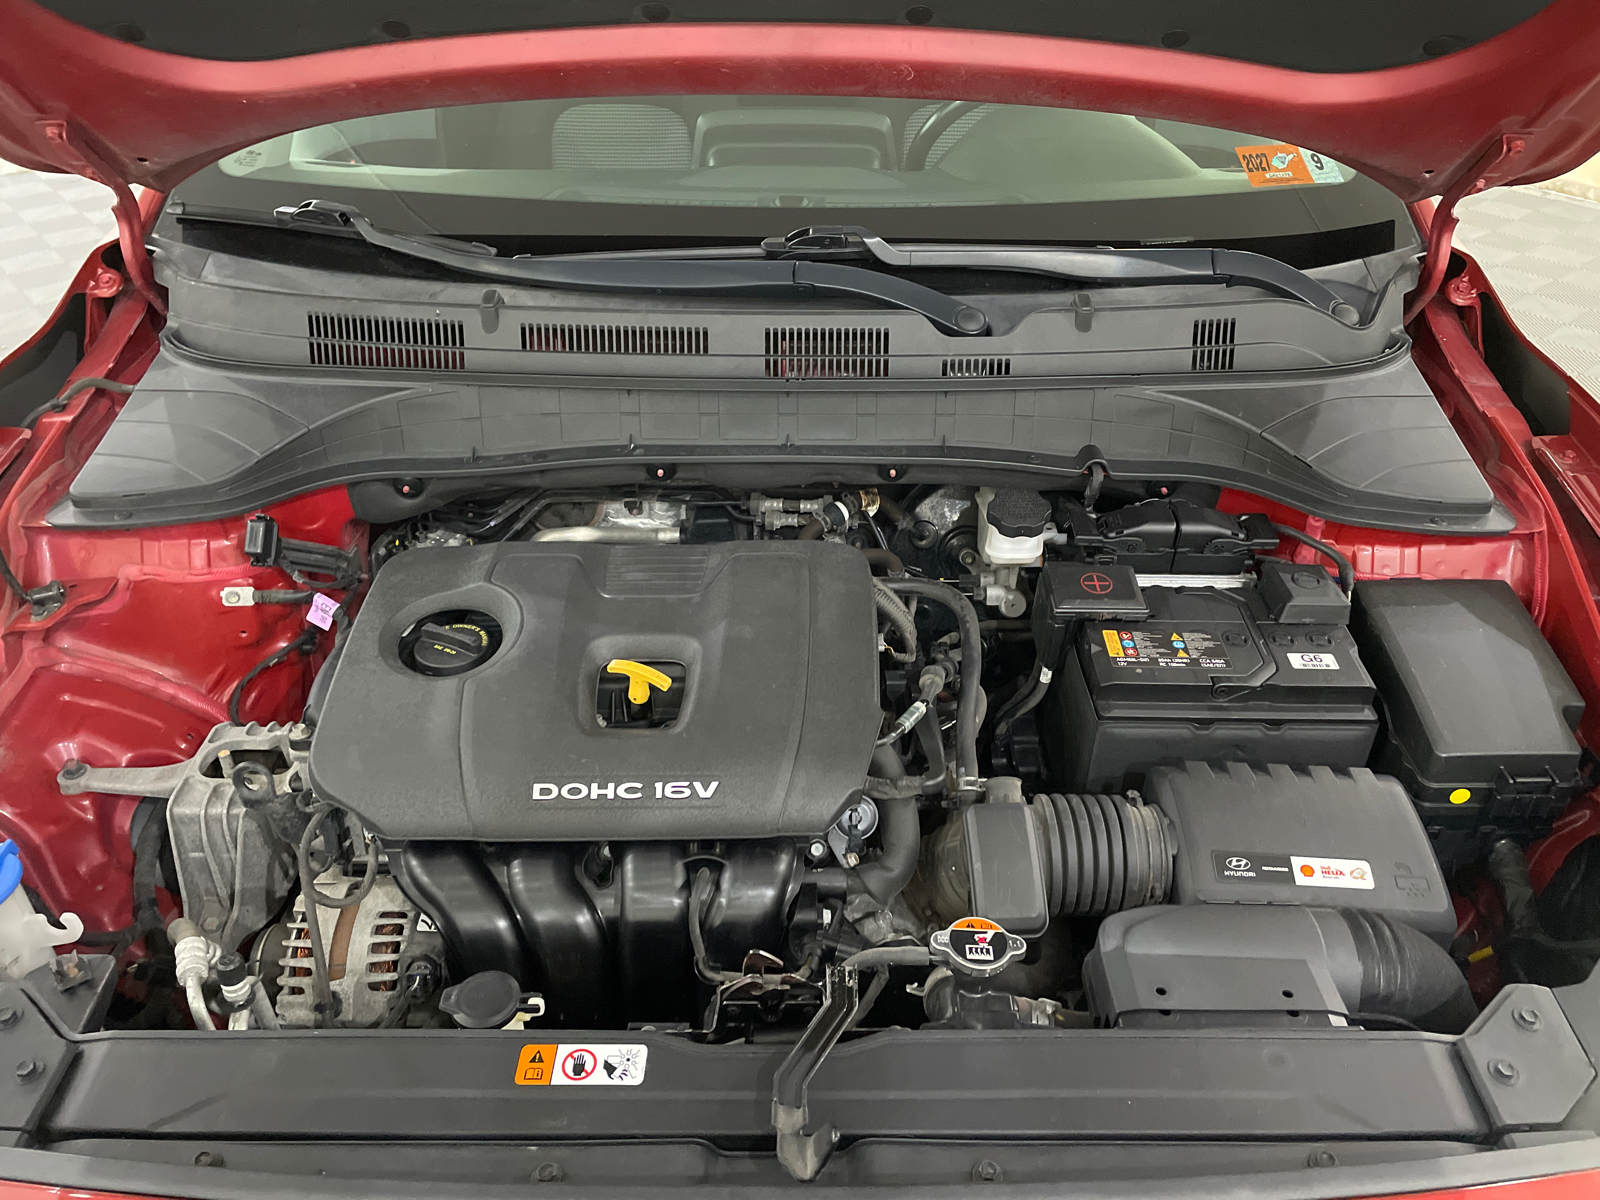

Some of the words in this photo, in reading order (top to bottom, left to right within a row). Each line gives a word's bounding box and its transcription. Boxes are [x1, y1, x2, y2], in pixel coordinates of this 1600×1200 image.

[1242, 153, 1271, 173] 2027
[1310, 153, 1324, 171] 9
[1300, 654, 1323, 663] G6
[532, 782, 644, 800] DOHC
[654, 781, 720, 799] 16V
